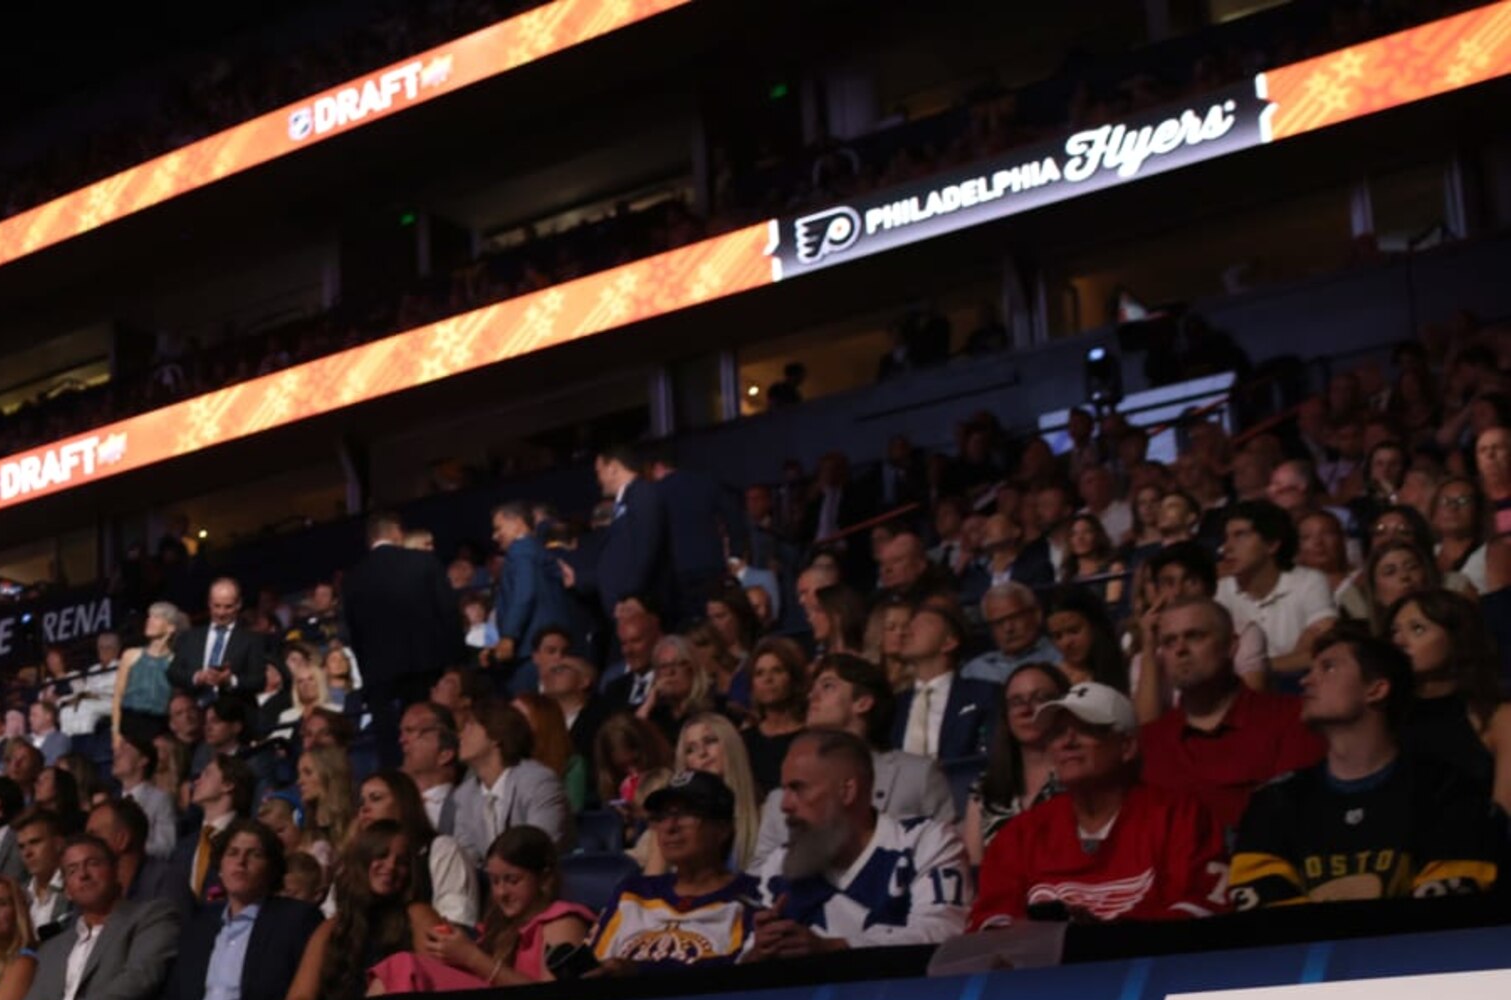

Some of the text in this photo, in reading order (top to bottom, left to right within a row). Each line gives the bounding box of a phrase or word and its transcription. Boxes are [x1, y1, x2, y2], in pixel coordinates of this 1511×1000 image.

[314, 61, 423, 135] DRAFT
[865, 100, 1237, 235] PHILADELPHIA Flyers
[0, 436, 100, 499] DRAFT
[42, 597, 113, 642] RENA
[1304, 849, 1394, 879] OSTO
